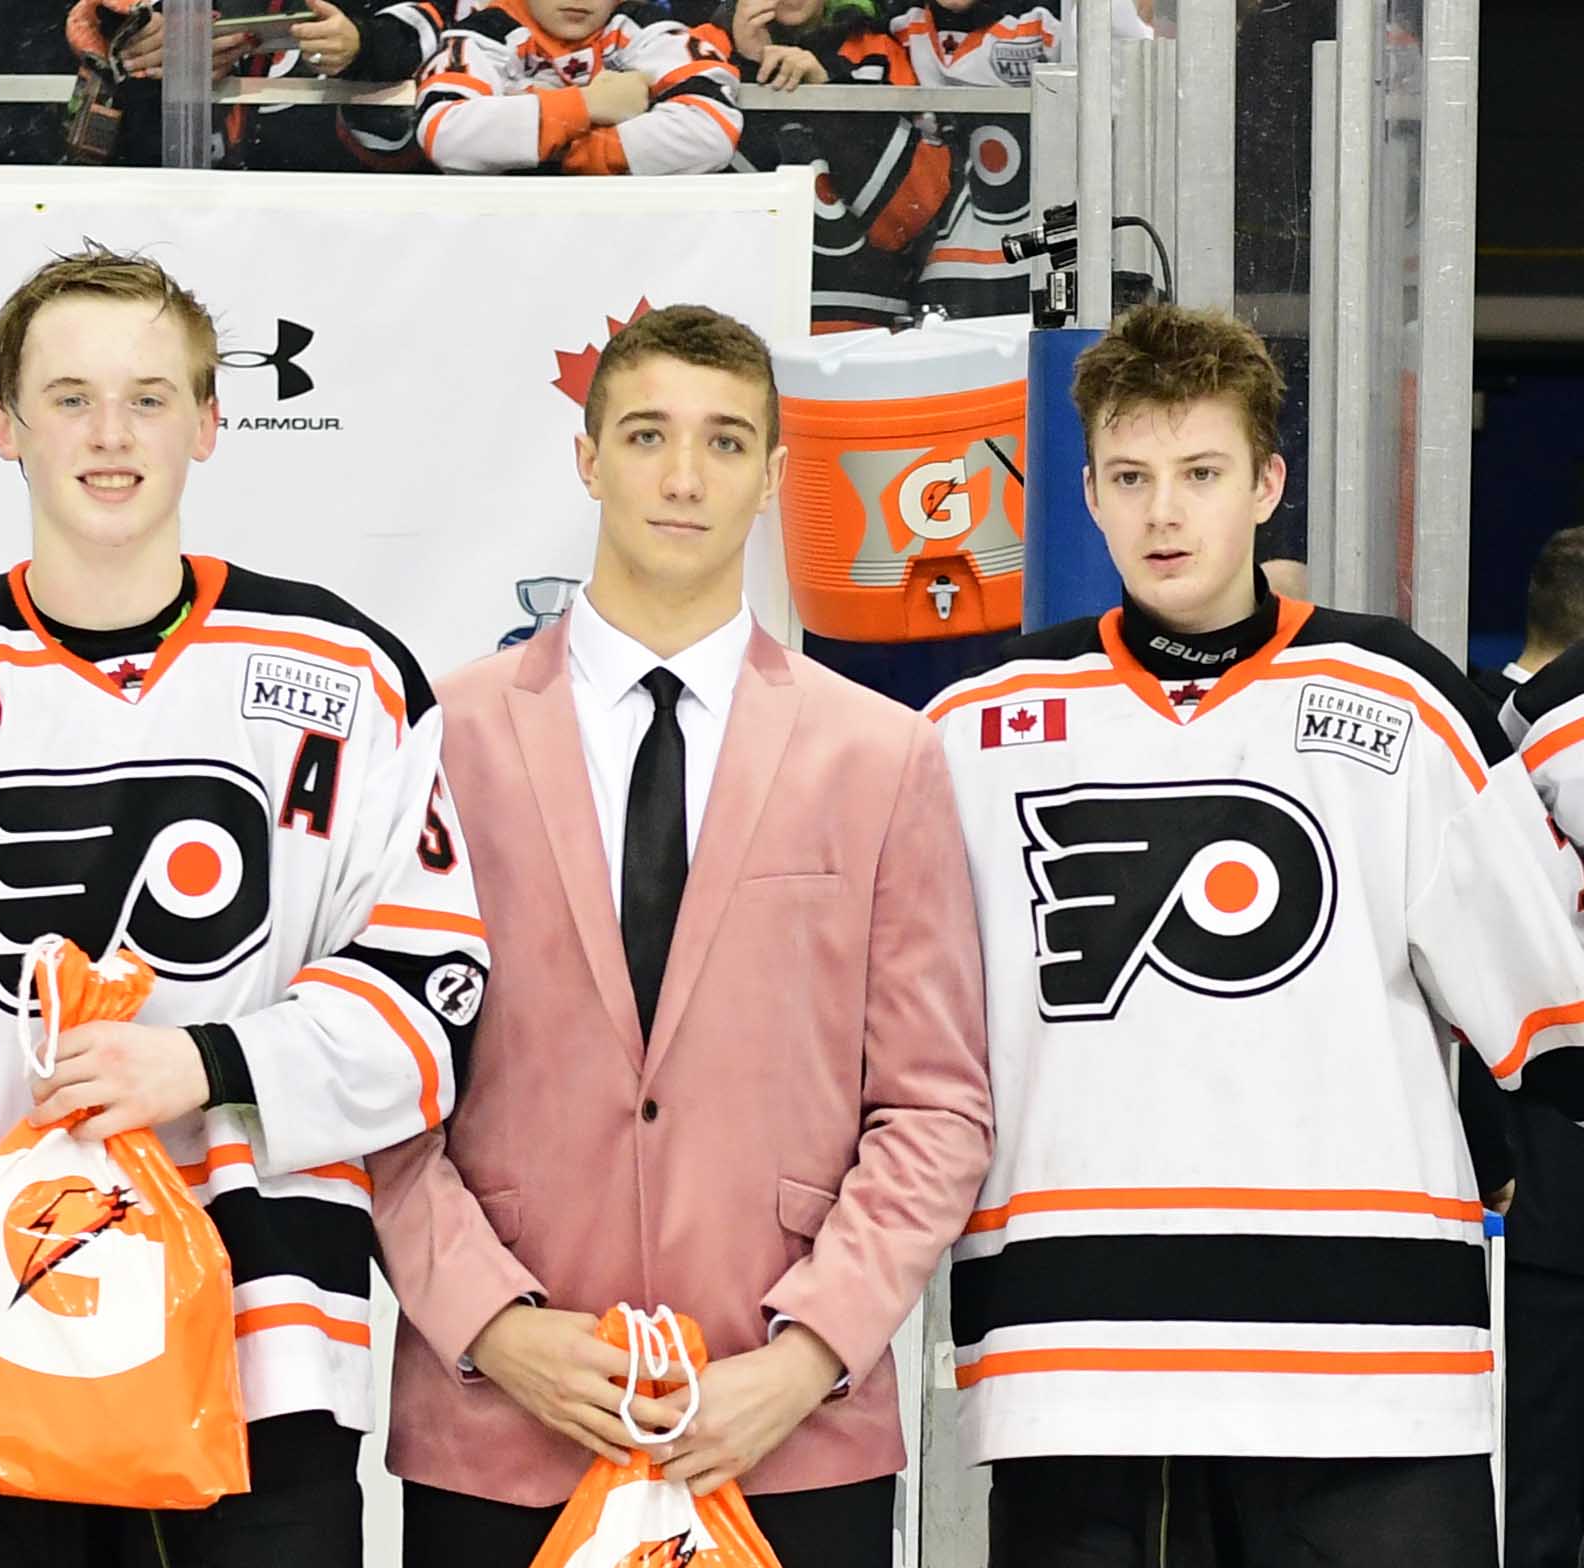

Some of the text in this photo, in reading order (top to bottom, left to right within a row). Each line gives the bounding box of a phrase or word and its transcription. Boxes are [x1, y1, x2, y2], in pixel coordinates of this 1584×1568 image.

[237, 417, 343, 430] ARMOUR
[256, 661, 330, 690] RECHARGE
[252, 681, 346, 726] MILK
[1308, 693, 1383, 723] RECHARGE
[1302, 714, 1396, 757] MILK
[278, 729, 348, 840] A
